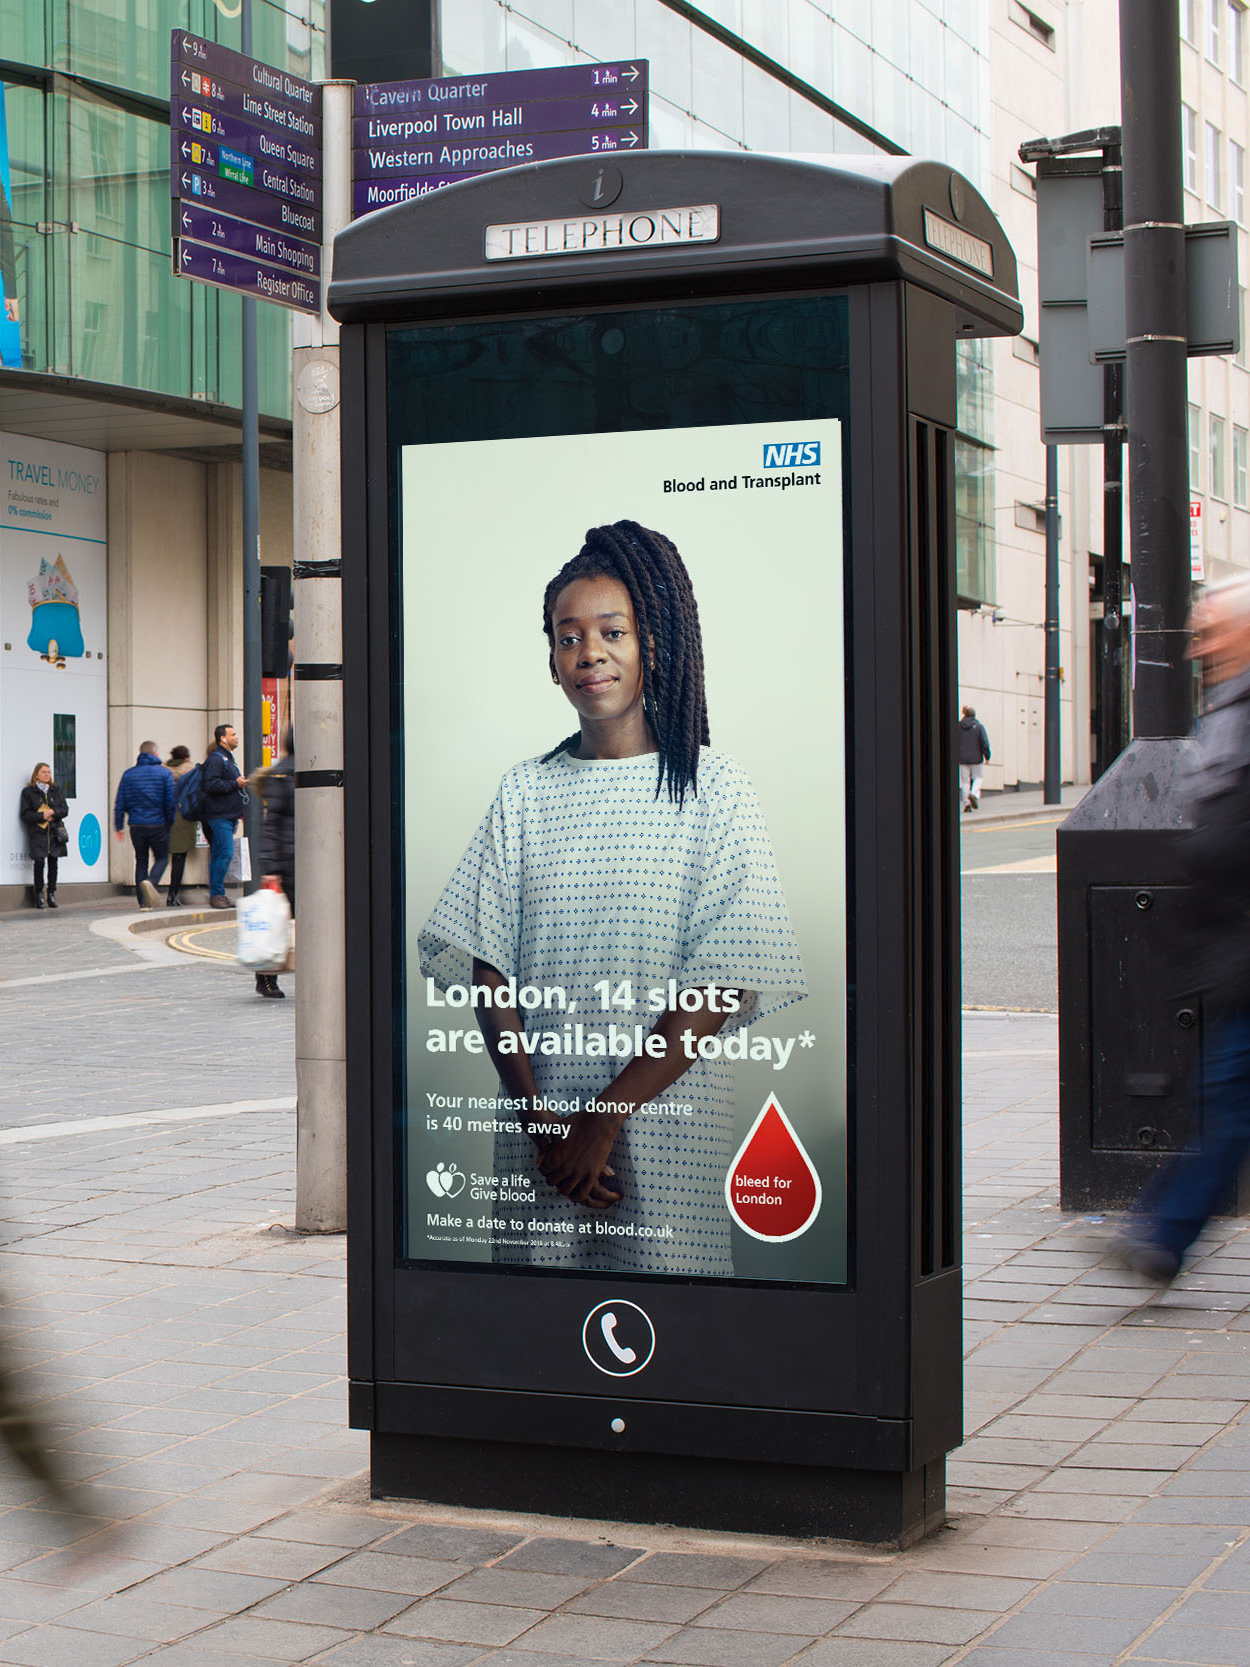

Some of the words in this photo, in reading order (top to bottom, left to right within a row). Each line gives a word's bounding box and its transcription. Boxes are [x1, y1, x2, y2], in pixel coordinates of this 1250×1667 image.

[192, 42, 198, 56] 9
[252, 64, 283, 93] Cultural
[284, 77, 313, 103] Quarter
[594, 70, 600, 85] 1
[602, 75, 618, 84] min
[211, 82, 216, 98] 8
[370, 88, 421, 106] Cavern
[428, 82, 488, 102] Quarter
[243, 92, 262, 117] Lime
[263, 101, 287, 127] Street
[287, 110, 314, 137] Station
[368, 114, 438, 139] Liverpool
[443, 113, 485, 132] Town
[492, 106, 523, 127] Hall
[590, 103, 600, 118] 4
[602, 108, 617, 117] min
[211, 118, 217, 133] 6
[259, 134, 286, 160] Queen
[286, 144, 315, 170] Square
[369, 150, 433, 169] Western
[439, 140, 534, 167] Approaches
[591, 135, 600, 150] 5
[602, 140, 617, 150] min
[201, 148, 206, 163] 7
[221, 150, 242, 166] Northern
[202, 180, 207, 195] 3
[262, 169, 288, 194] Central
[290, 178, 314, 202] Station
[212, 221, 217, 236] 2
[281, 204, 315, 232] Bluecoat
[502, 210, 704, 255] TELEPHONE
[926, 214, 986, 271] TELEPHONE
[212, 258, 217, 272] 7
[256, 234, 276, 256] Main
[277, 241, 314, 272] Shopping
[257, 270, 290, 296] Register
[291, 281, 314, 304] Office
[764, 442, 818, 467] NHS
[8, 460, 54, 487] TRAVEL
[57, 468, 100, 495] MONEY
[663, 476, 705, 493] Blood
[709, 476, 738, 491] and
[742, 472, 822, 491] Transplant
[426, 976, 578, 1015] London,
[592, 979, 636, 1010] 14
[648, 979, 741, 1013] slots
[426, 1028, 484, 1054] are
[497, 1023, 668, 1059] available
[426, 1092, 464, 1111] Your
[468, 1096, 528, 1112] nearest
[532, 1095, 580, 1114] blood
[584, 1098, 636, 1115] donor
[640, 1100, 692, 1117] centre
[426, 1116, 438, 1132] is
[442, 1116, 462, 1132] 40
[467, 1118, 522, 1134] metres
[527, 1122, 572, 1139] away
[470, 1173, 499, 1187] Save
[502, 1177, 508, 1187] a
[511, 1174, 531, 1188] life
[734, 1174, 770, 1188] bleed
[772, 1175, 792, 1189] for
[470, 1188, 498, 1200] Give
[500, 1188, 536, 1202] blood
[735, 1192, 782, 1206] London
[426, 1213, 462, 1227] Make
[466, 1218, 474, 1228] a
[477, 1215, 506, 1230] date
[510, 1218, 524, 1230] to
[528, 1218, 575, 1233] donate
[578, 1220, 592, 1236] at
[595, 1221, 674, 1239] blood.co.uk
